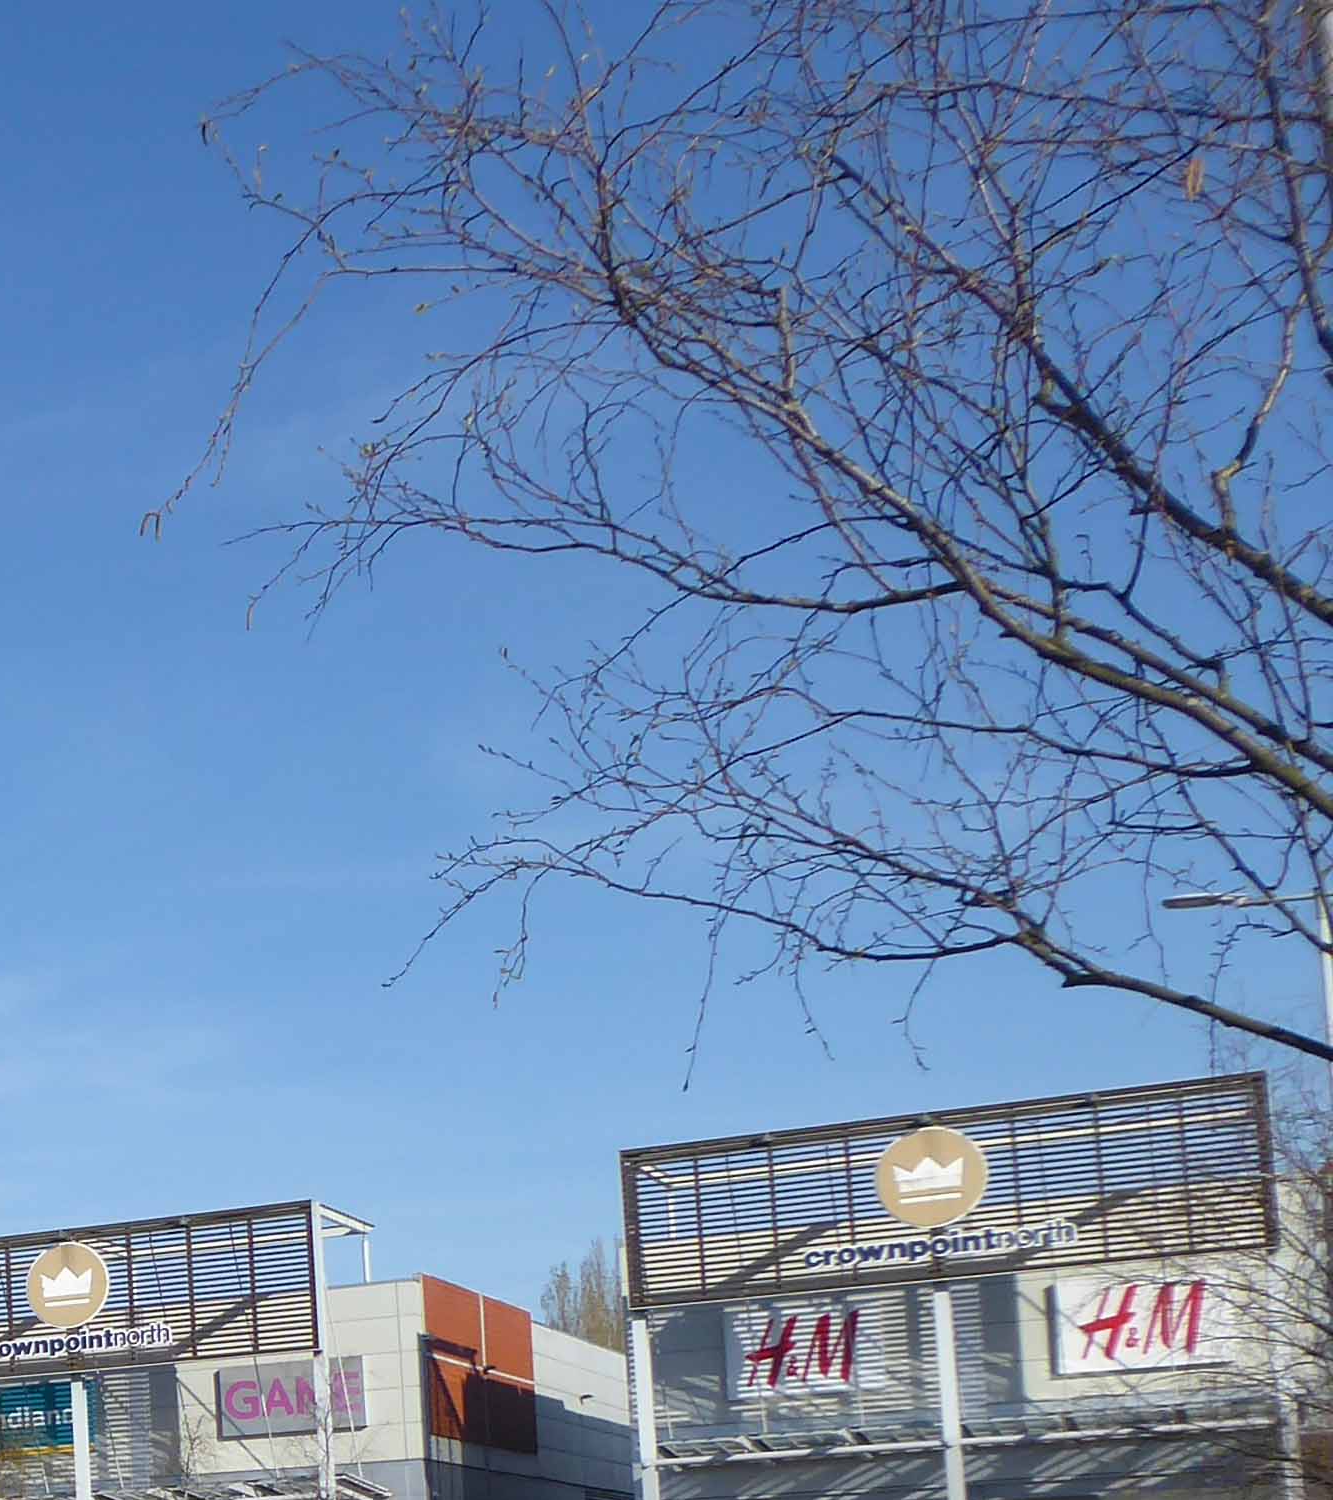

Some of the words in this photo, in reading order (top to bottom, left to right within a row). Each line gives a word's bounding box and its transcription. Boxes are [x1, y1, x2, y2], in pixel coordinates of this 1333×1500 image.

[805, 1217, 1077, 1269] crownpointnorth
[745, 1310, 860, 1388] H&M
[1077, 1280, 1207, 1361] H&M
